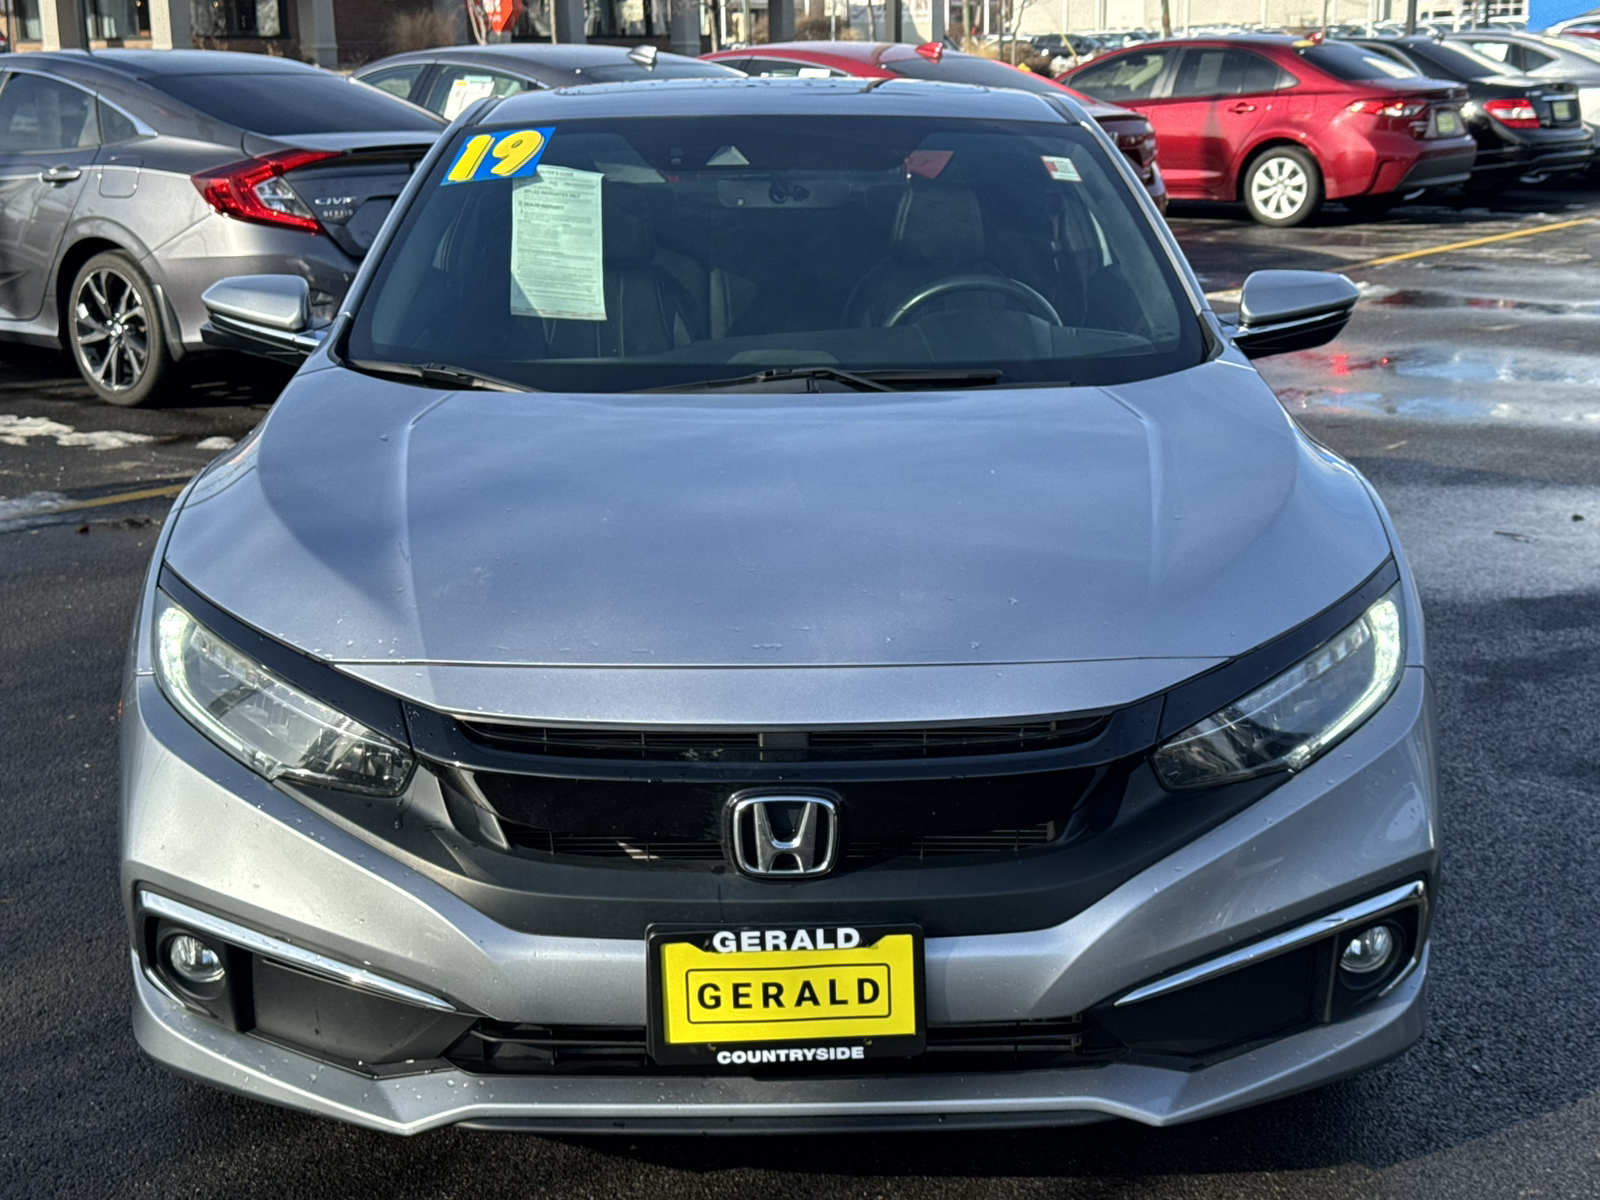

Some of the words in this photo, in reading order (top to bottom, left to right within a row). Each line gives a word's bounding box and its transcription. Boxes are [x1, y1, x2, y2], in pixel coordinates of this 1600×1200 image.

[448, 129, 545, 182] 19
[712, 927, 860, 953] GERALD
[697, 977, 881, 1010] GERALD
[716, 1046, 865, 1065] COUNTRYSIDE
